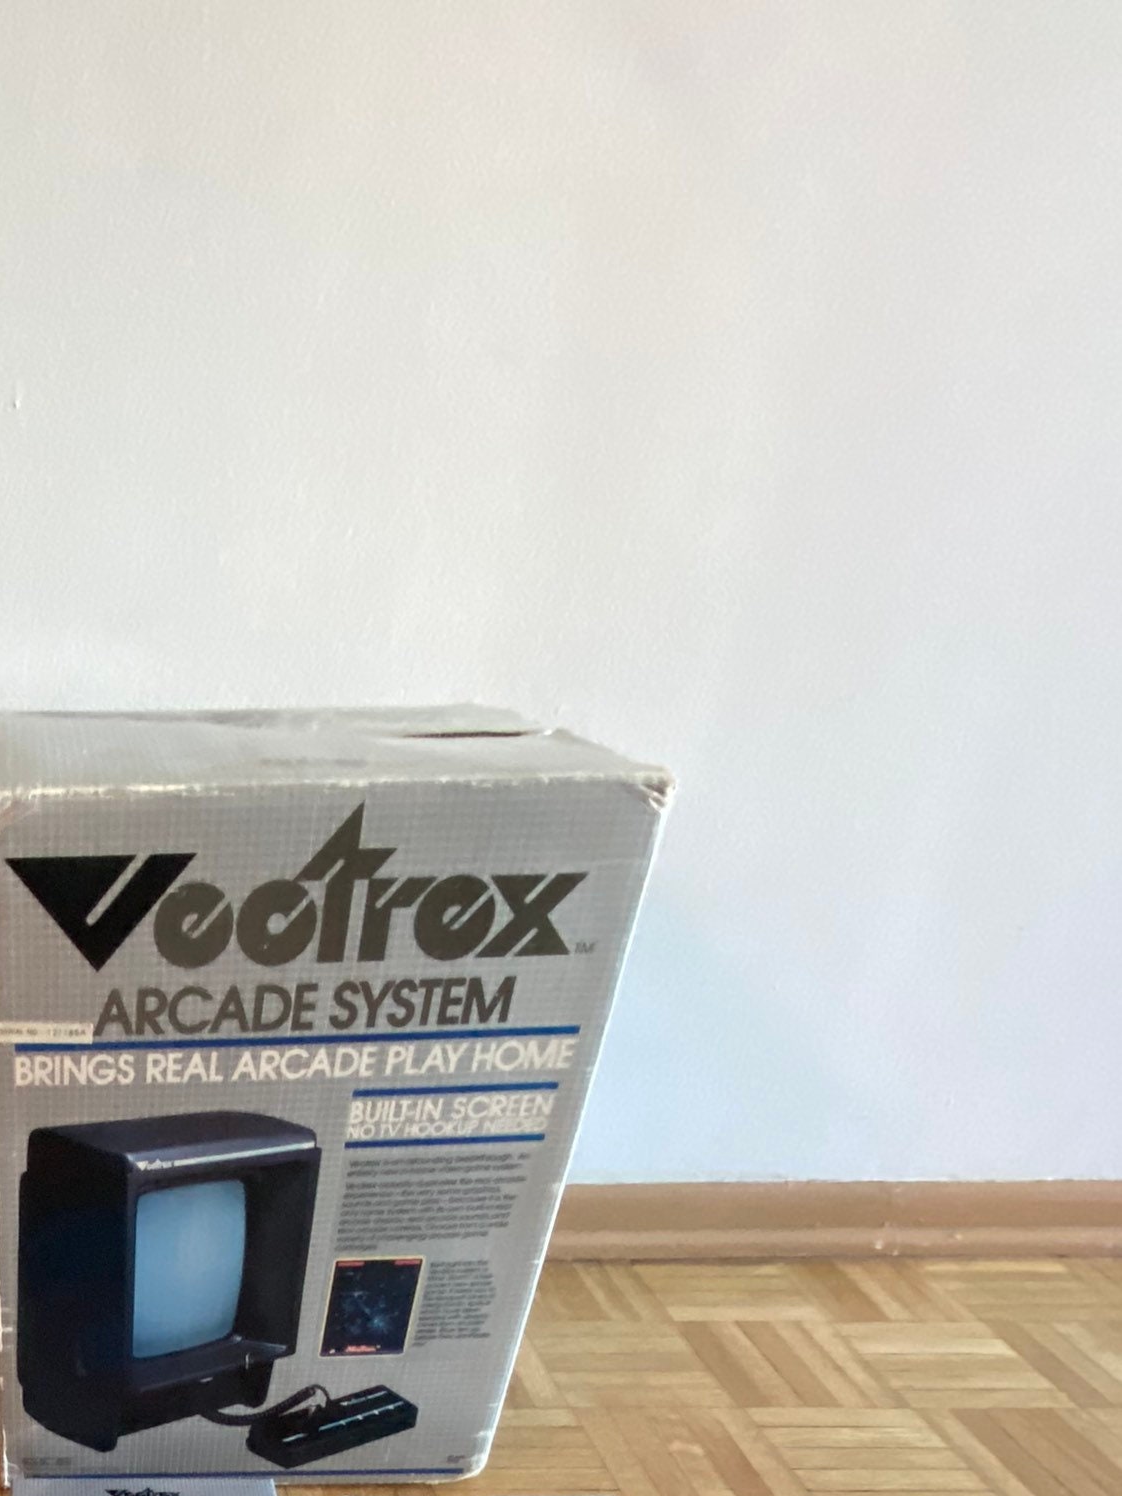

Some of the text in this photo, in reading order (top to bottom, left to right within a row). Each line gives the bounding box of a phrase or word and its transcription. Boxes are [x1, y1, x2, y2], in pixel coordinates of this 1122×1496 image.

[5, 801, 589, 972] Vectrex
[93, 976, 517, 1036] ARCADE SYSTEM
[14, 1039, 579, 1087] BRINGS REAL ARCADE PLAY HOME
[346, 1116, 548, 1139] NO TV HOOKUP NEEDED
[349, 1093, 556, 1124] BUILT-IN SCREEN
